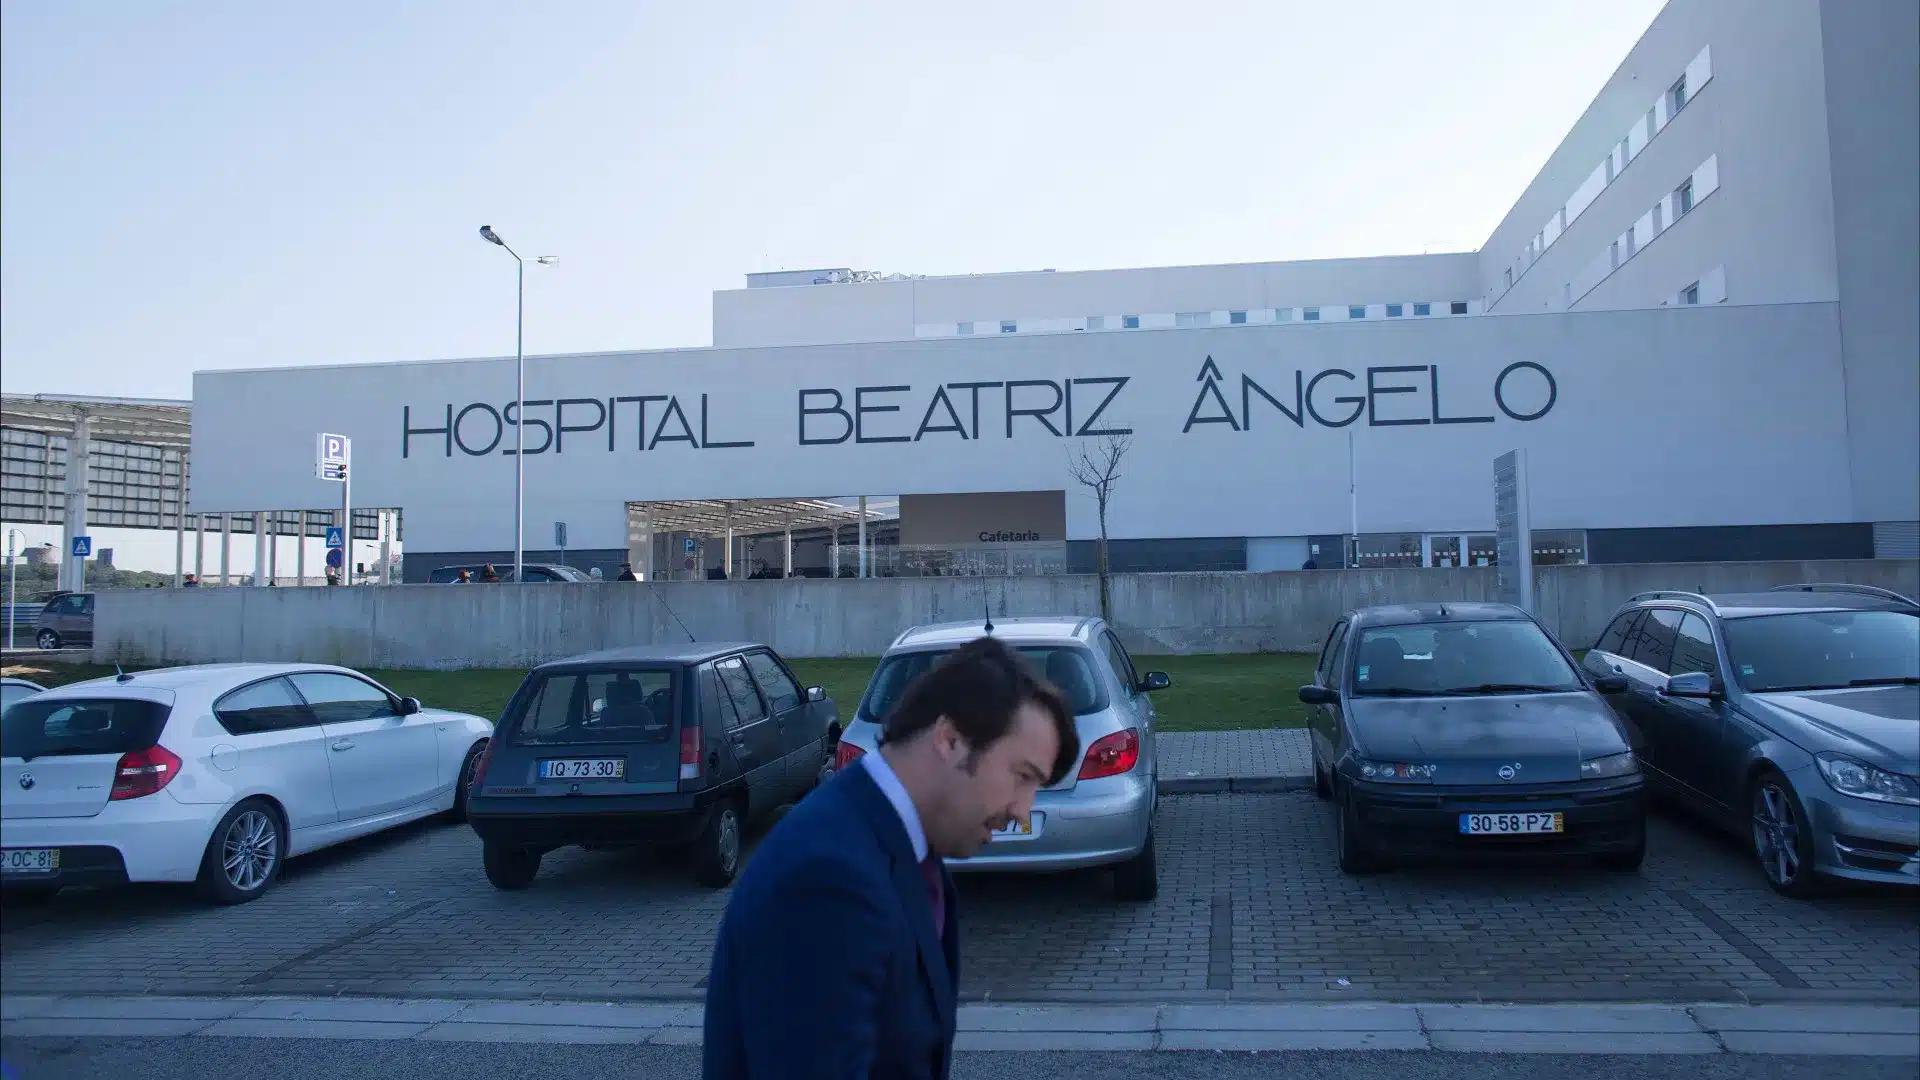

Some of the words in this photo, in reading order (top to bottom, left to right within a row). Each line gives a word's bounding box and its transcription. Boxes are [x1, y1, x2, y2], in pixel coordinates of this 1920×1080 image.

[403, 393, 755, 459] HOSPITAL
[799, 376, 1133, 445] BEATRIZ
[1182, 354, 1557, 433] ÂNGELO
[329, 439, 340, 459] P
[978, 530, 1039, 542] Cafetaria
